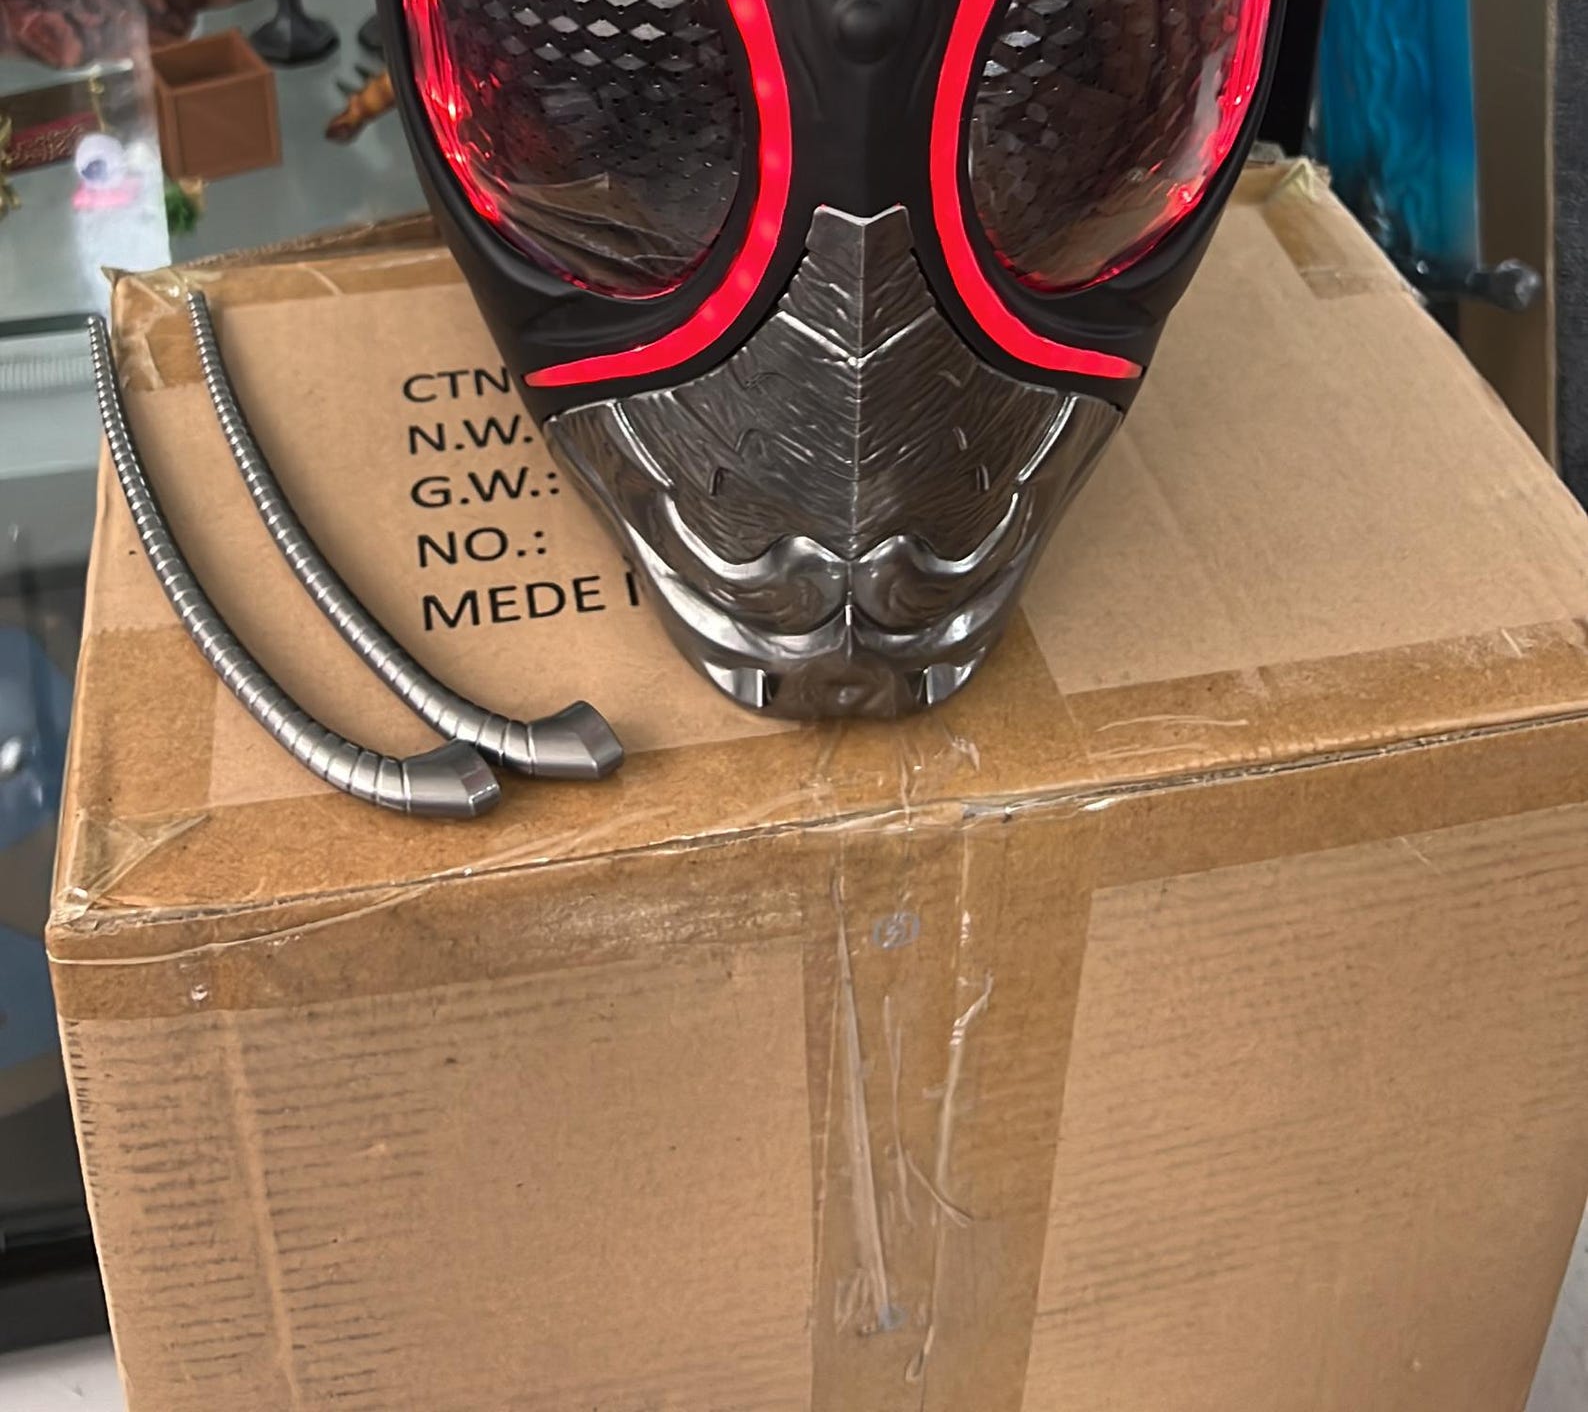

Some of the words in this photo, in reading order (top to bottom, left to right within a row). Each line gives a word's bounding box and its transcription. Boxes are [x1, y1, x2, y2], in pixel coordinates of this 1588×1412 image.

[403, 367, 511, 403] CTN
[410, 466, 559, 508] G.W.:
[417, 527, 547, 568] NO.:
[422, 575, 606, 631] MEDE
